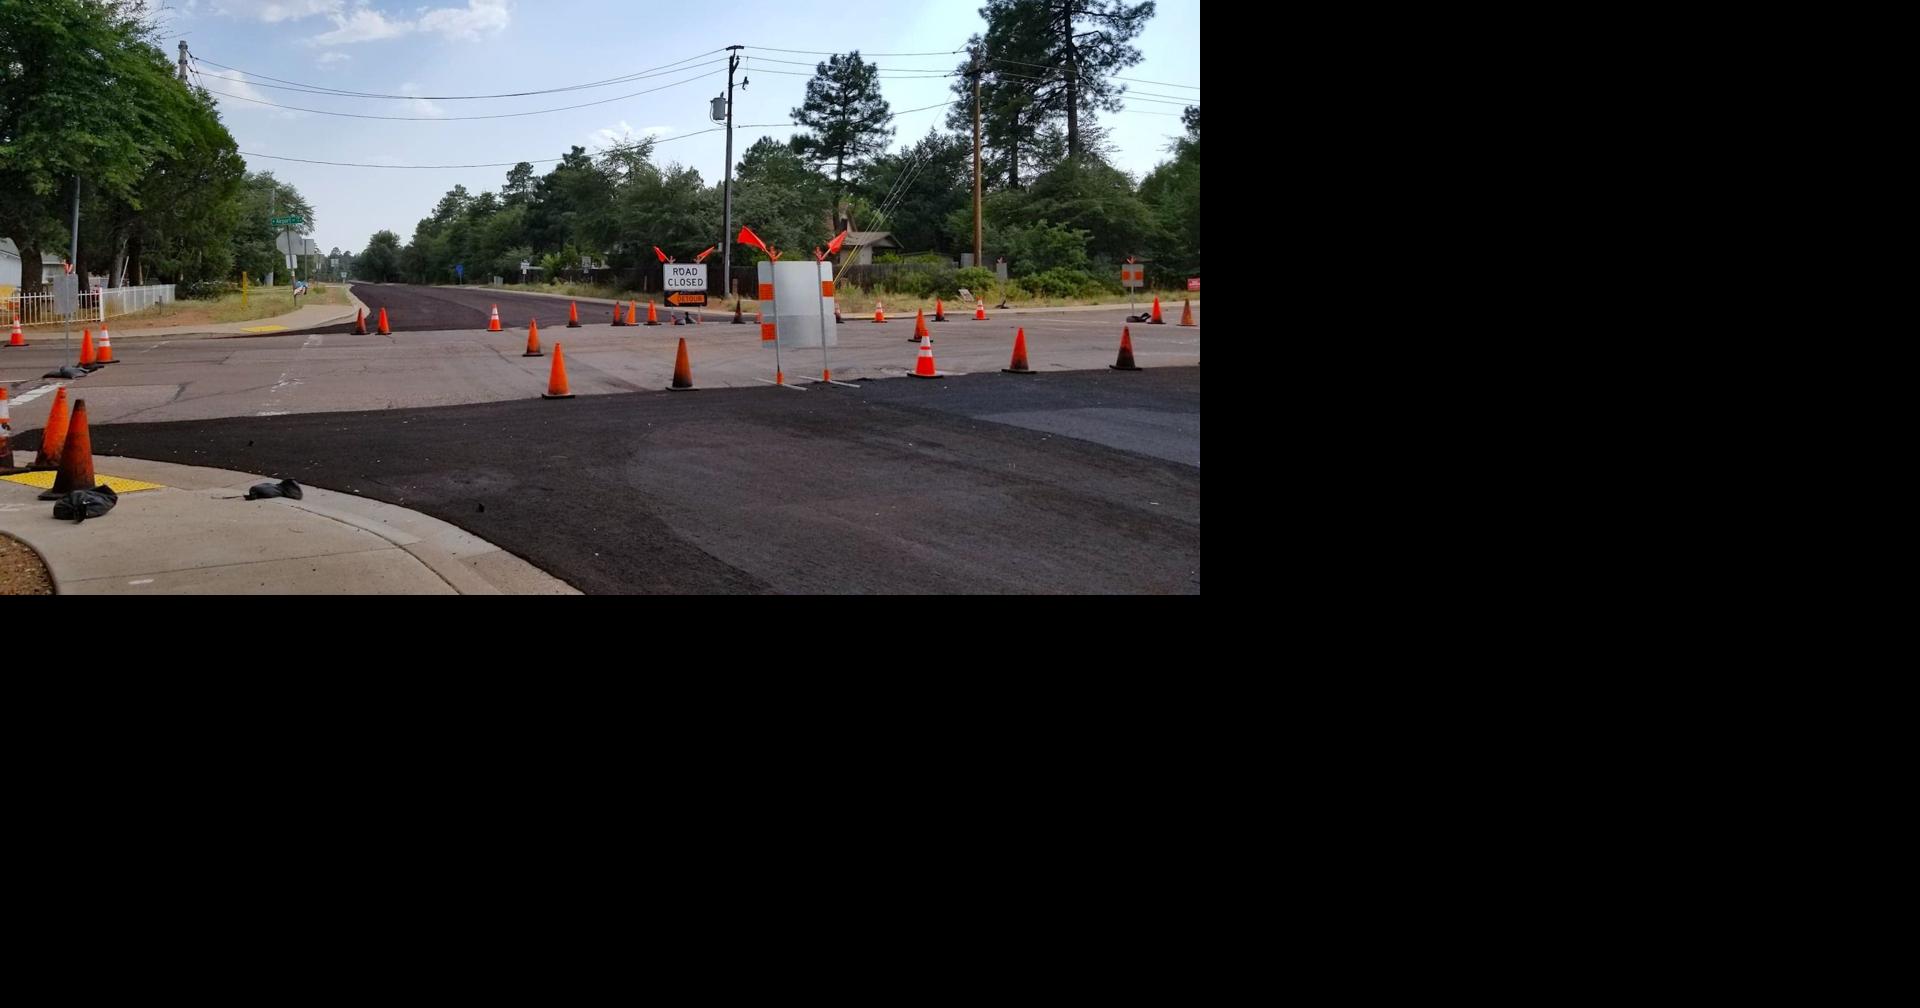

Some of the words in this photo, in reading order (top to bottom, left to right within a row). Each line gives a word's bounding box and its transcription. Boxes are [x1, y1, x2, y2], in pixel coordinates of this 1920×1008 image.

[672, 267, 698, 276] ROAD
[667, 278, 704, 287] CLOSED
[678, 295, 703, 303] DETOUR
